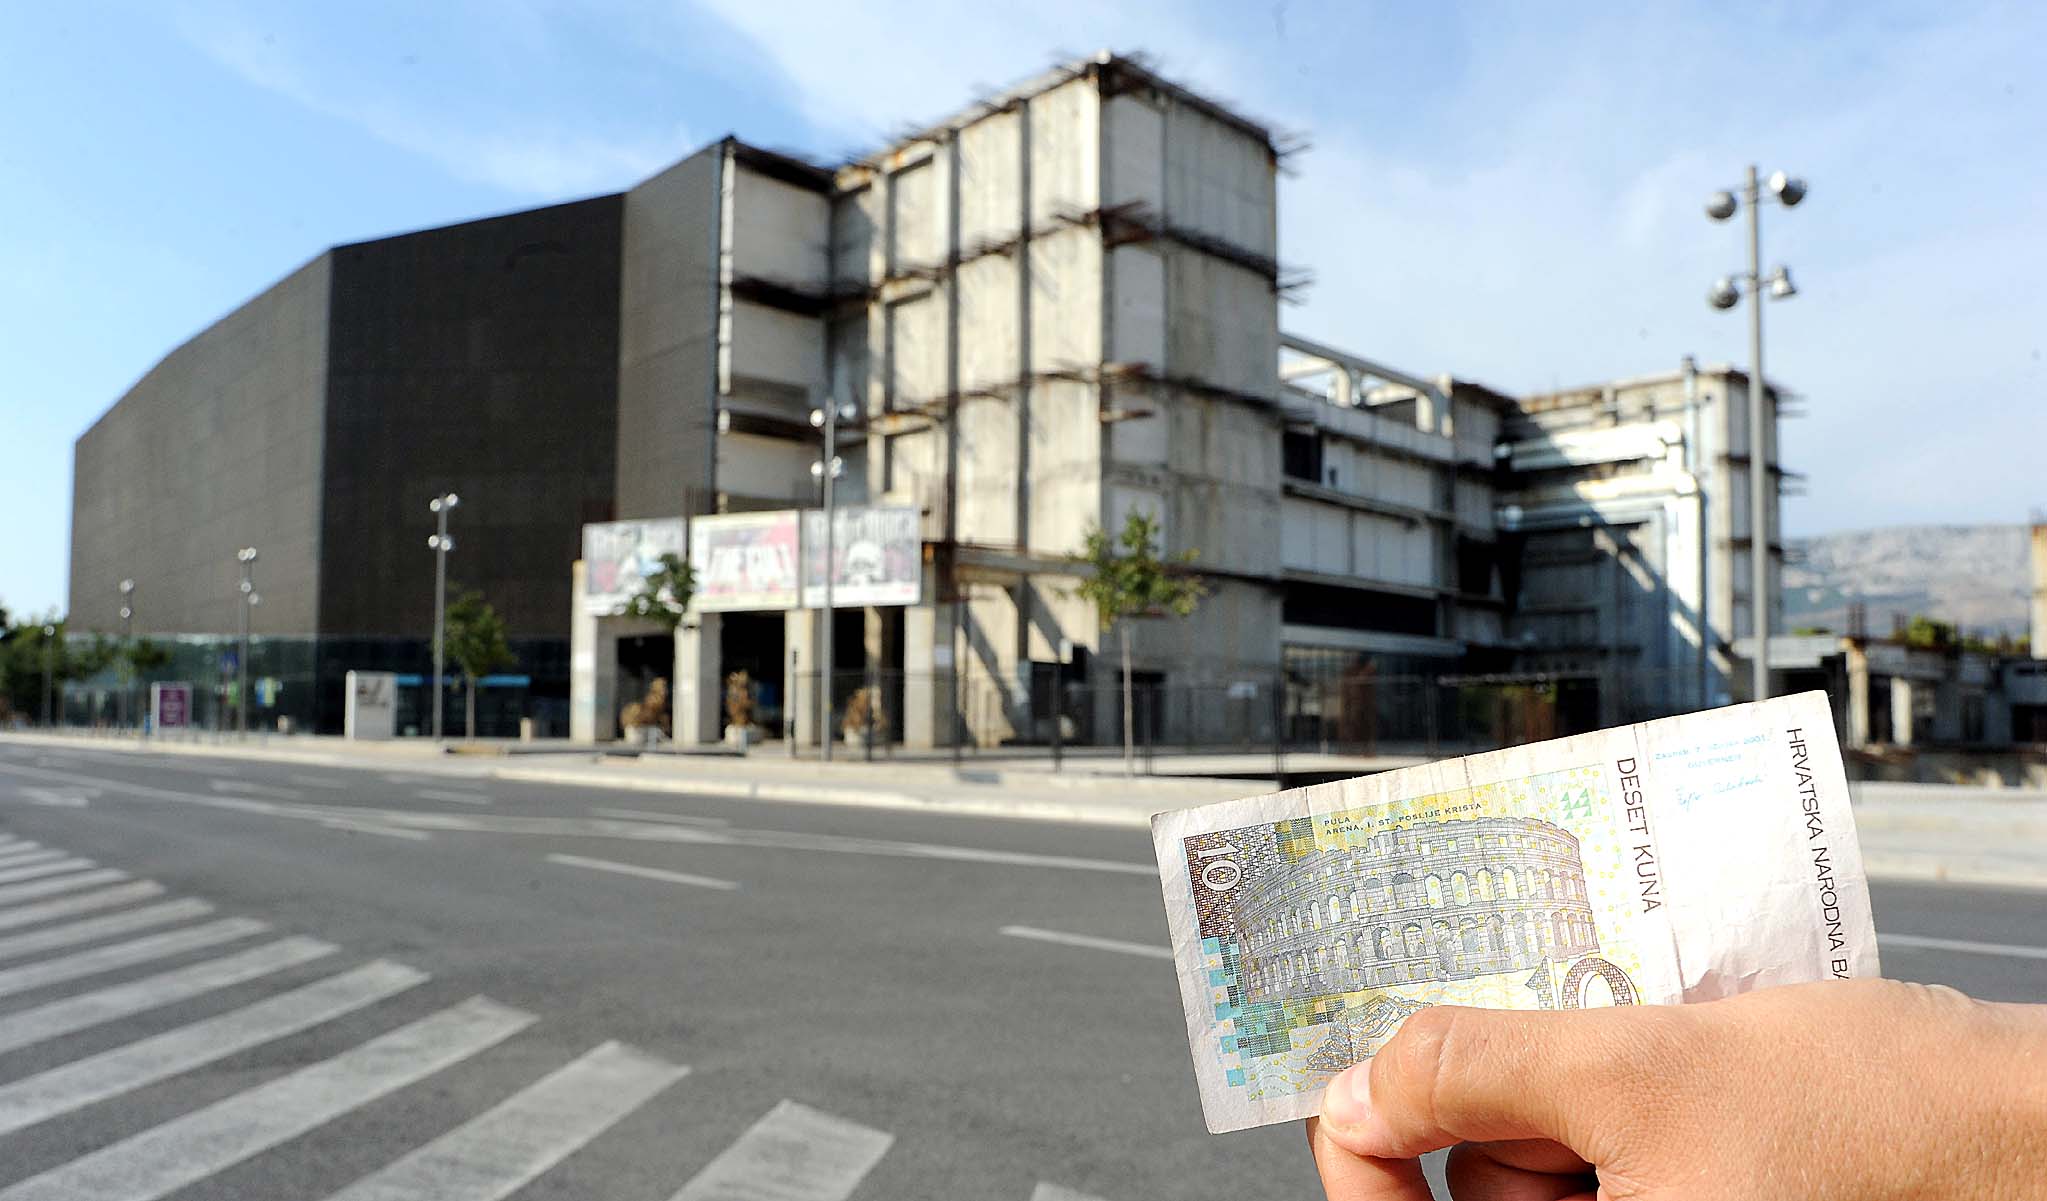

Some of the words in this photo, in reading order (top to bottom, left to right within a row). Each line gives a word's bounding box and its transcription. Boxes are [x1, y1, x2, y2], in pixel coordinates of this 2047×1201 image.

[1324, 816, 1351, 827] PULA
[1398, 809, 1441, 823] POSLIJE
[1445, 802, 1482, 815] KRISTA
[1616, 757, 1649, 835] DESET
[1197, 840, 1242, 892] 10
[1786, 727, 1824, 841] HRVATSKA
[1811, 846, 1845, 952] NARODNA
[1632, 844, 1662, 914] KUNA
